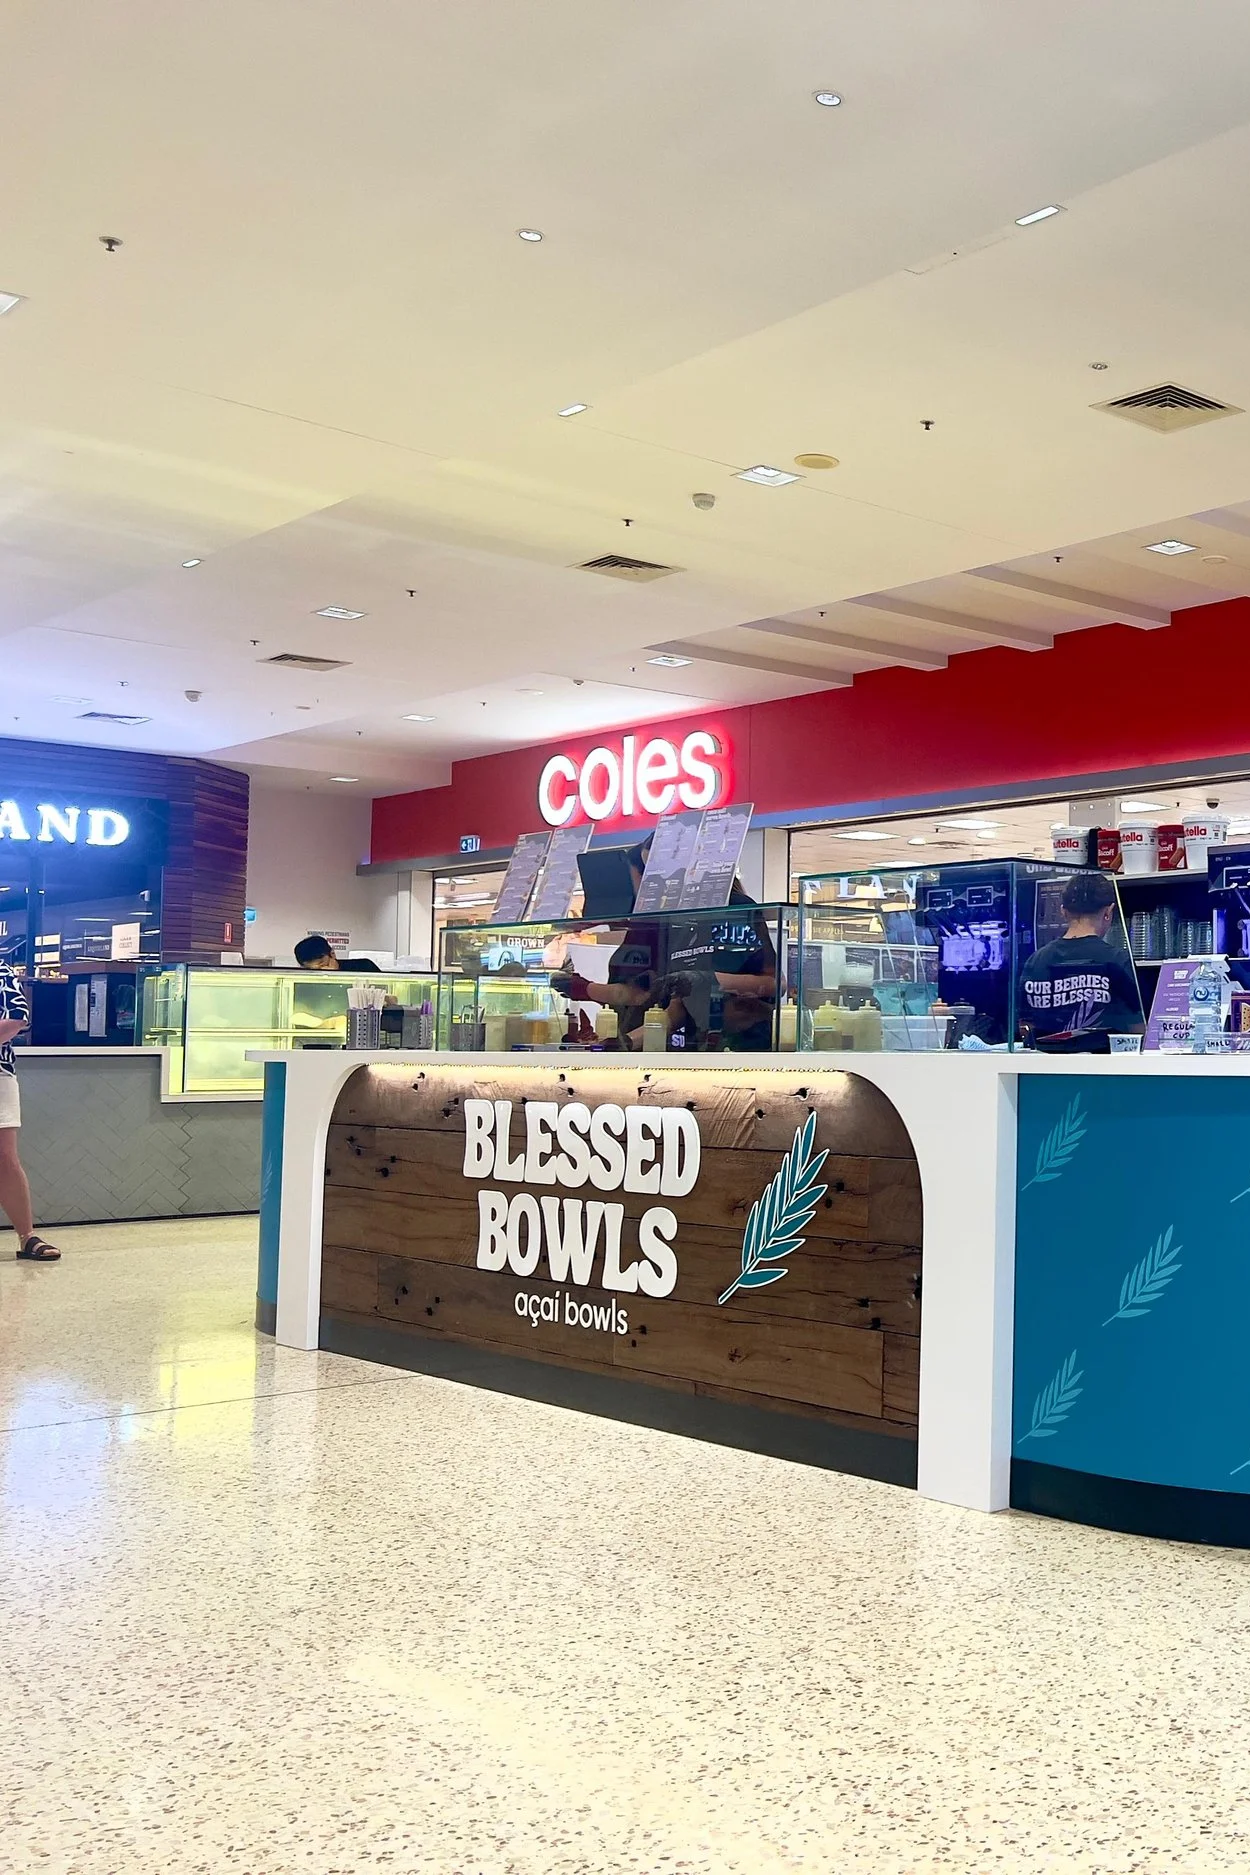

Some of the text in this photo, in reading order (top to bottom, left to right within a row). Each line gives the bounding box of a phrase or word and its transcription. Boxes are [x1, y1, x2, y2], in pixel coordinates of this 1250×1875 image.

[538, 731, 718, 826] coles
[1025, 974, 1110, 995] OUR BERRIES
[1053, 988, 1112, 1008] BLESSED
[1172, 1032, 1191, 1040] CUP
[463, 1098, 702, 1198] BLESSED
[475, 1189, 678, 1298] BOWLS
[514, 1290, 629, 1335] açaí bowls
